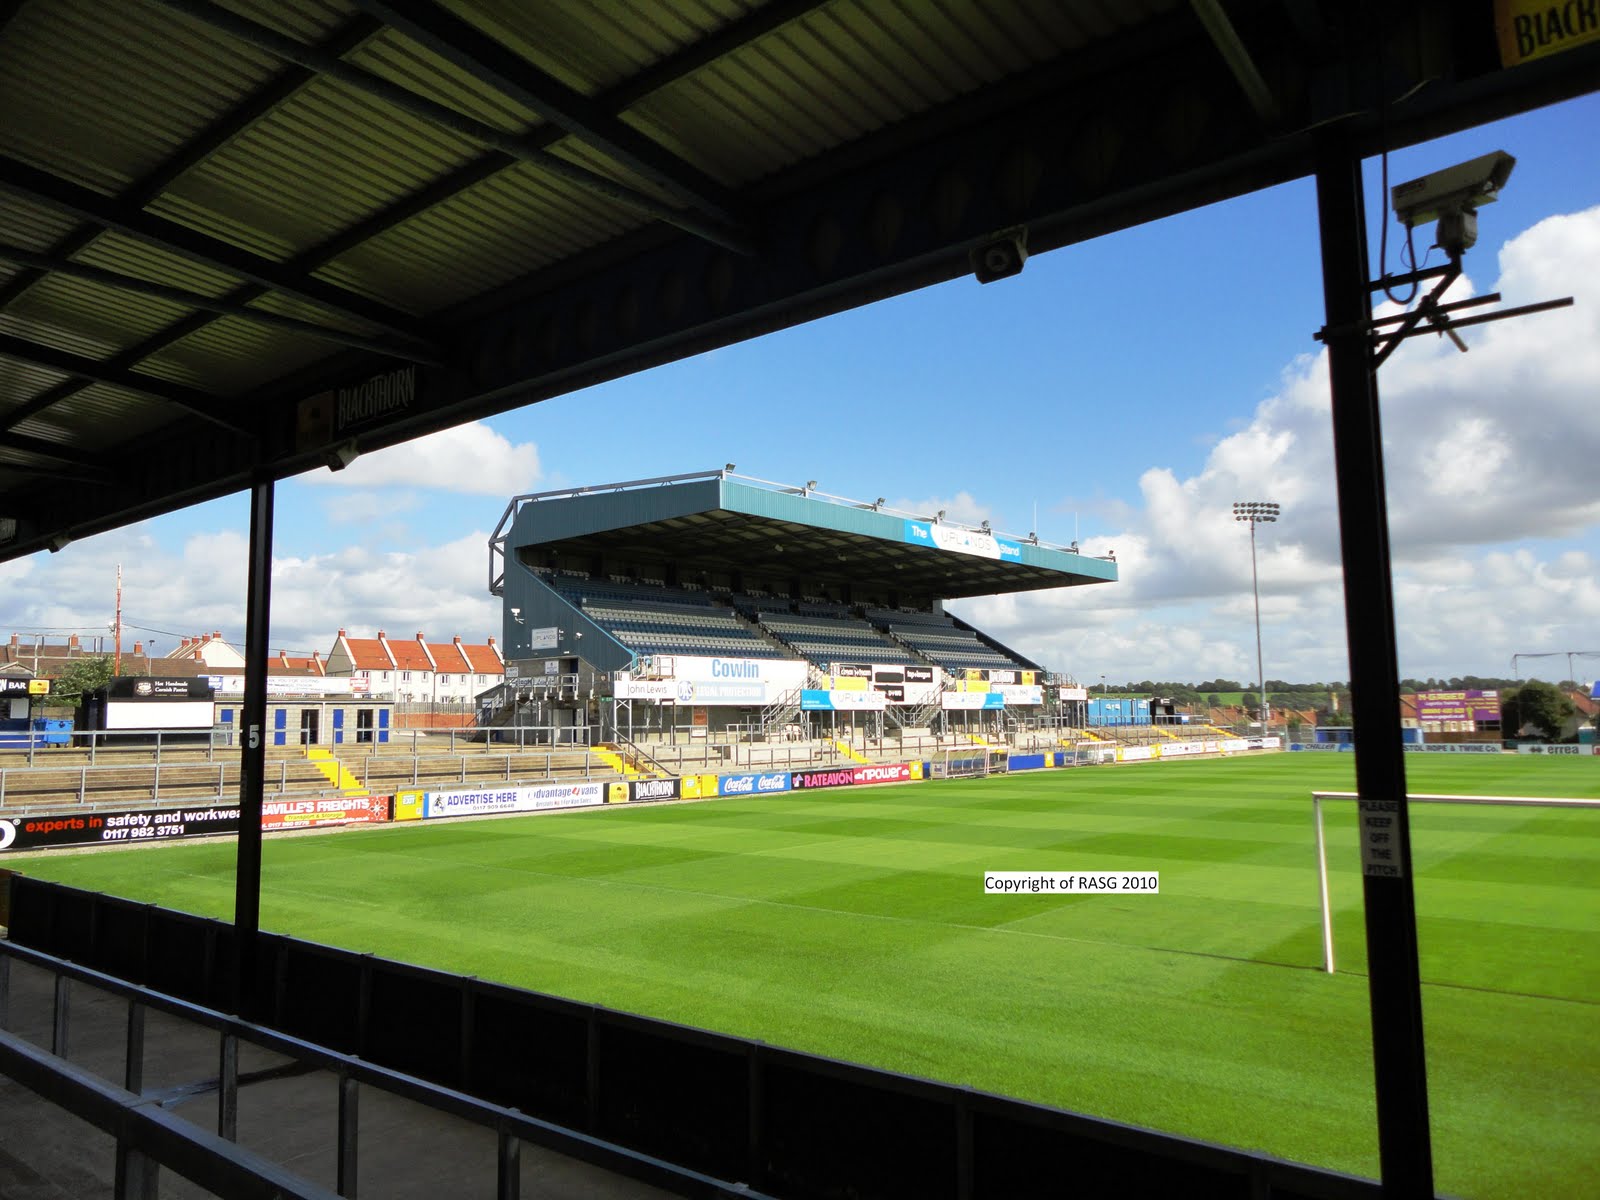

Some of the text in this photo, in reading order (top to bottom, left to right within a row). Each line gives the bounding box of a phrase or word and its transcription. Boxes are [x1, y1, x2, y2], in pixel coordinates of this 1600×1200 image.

[338, 364, 416, 431] BLACKTHORN
[912, 525, 927, 538] The
[1000, 543, 1020, 556] Stand
[712, 659, 759, 678] Cowlin
[8, 682, 27, 690] BAR
[627, 684, 667, 696] John Lewis
[248, 724, 260, 749] 5
[804, 771, 853, 788] RATEAVON
[861, 766, 903, 781] npower
[262, 798, 370, 815] SAVILLE'S FREIGHTS
[447, 792, 517, 806] ADVERTISE HERE
[25, 809, 240, 833] experts in safety and workwea
[1366, 817, 1392, 828] KEEP
[103, 825, 184, 840] 0117 982 3751
[1370, 833, 1390, 843] OFF
[1371, 848, 1392, 859] THE
[1367, 864, 1398, 875] PITCH
